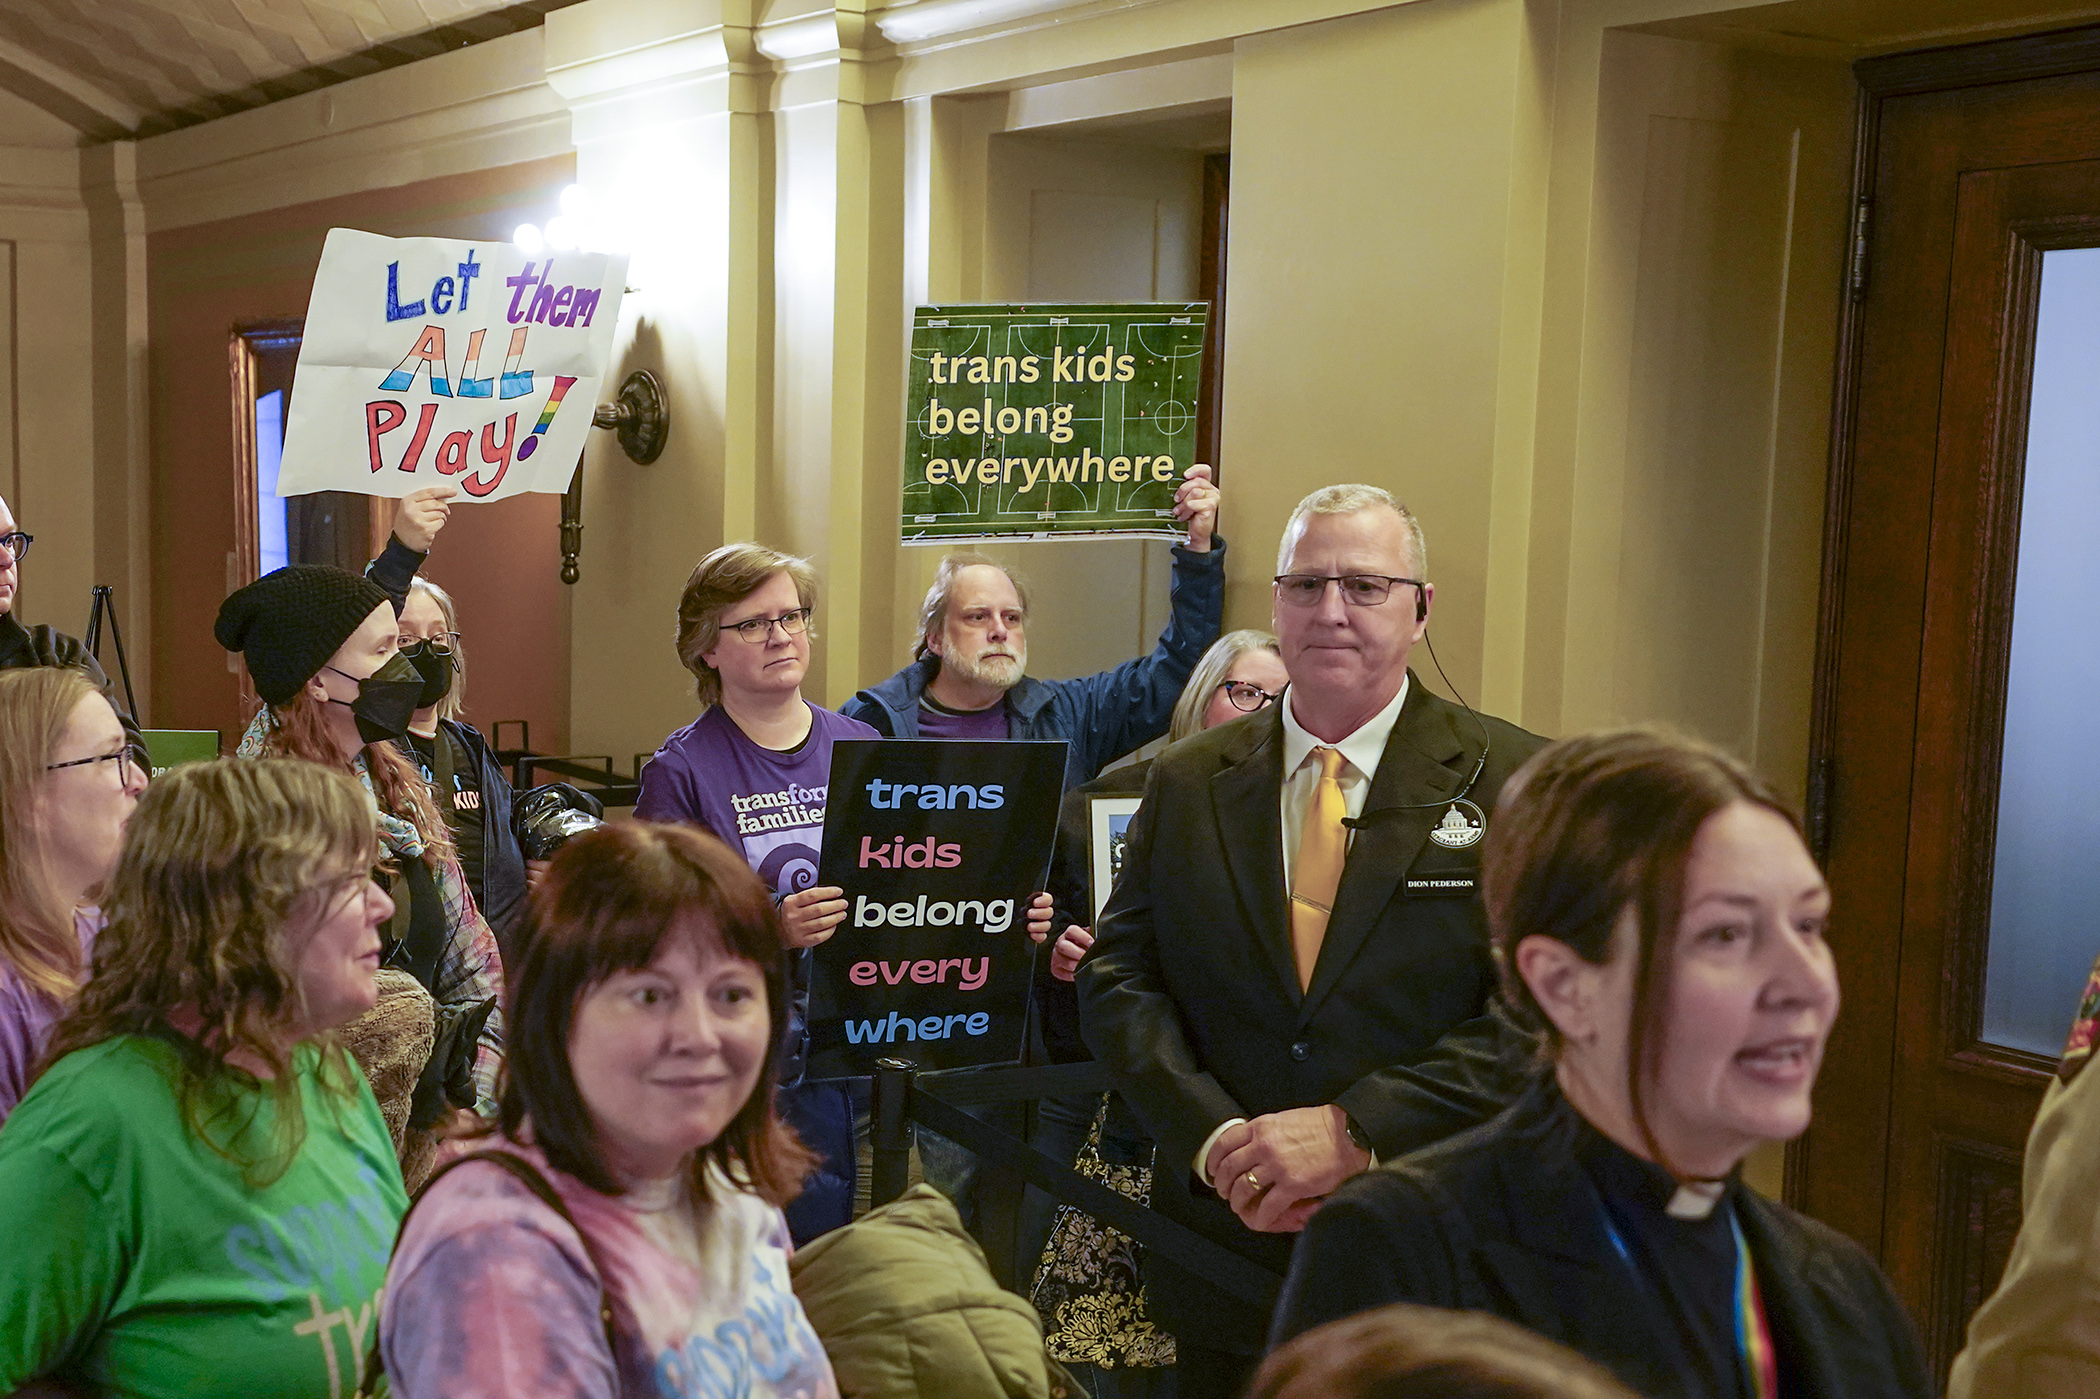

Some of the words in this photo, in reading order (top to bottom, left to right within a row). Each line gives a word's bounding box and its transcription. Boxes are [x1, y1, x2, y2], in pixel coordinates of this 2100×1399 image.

[386, 249, 481, 324] Let
[506, 258, 601, 328] them
[378, 324, 534, 400] ALL
[929, 351, 1041, 384] trans
[1052, 345, 1136, 383] kids
[365, 375, 578, 497] Play!
[928, 397, 1075, 444] belong
[925, 447, 1176, 494] everywhere
[453, 790, 480, 810] KID
[865, 778, 1005, 810] trans
[858, 835, 962, 869] kids
[1407, 880, 1429, 888] DION
[1430, 880, 1474, 888] PEDERSON
[854, 895, 1014, 933] belong
[849, 956, 990, 991] every
[844, 1011, 990, 1044] where
